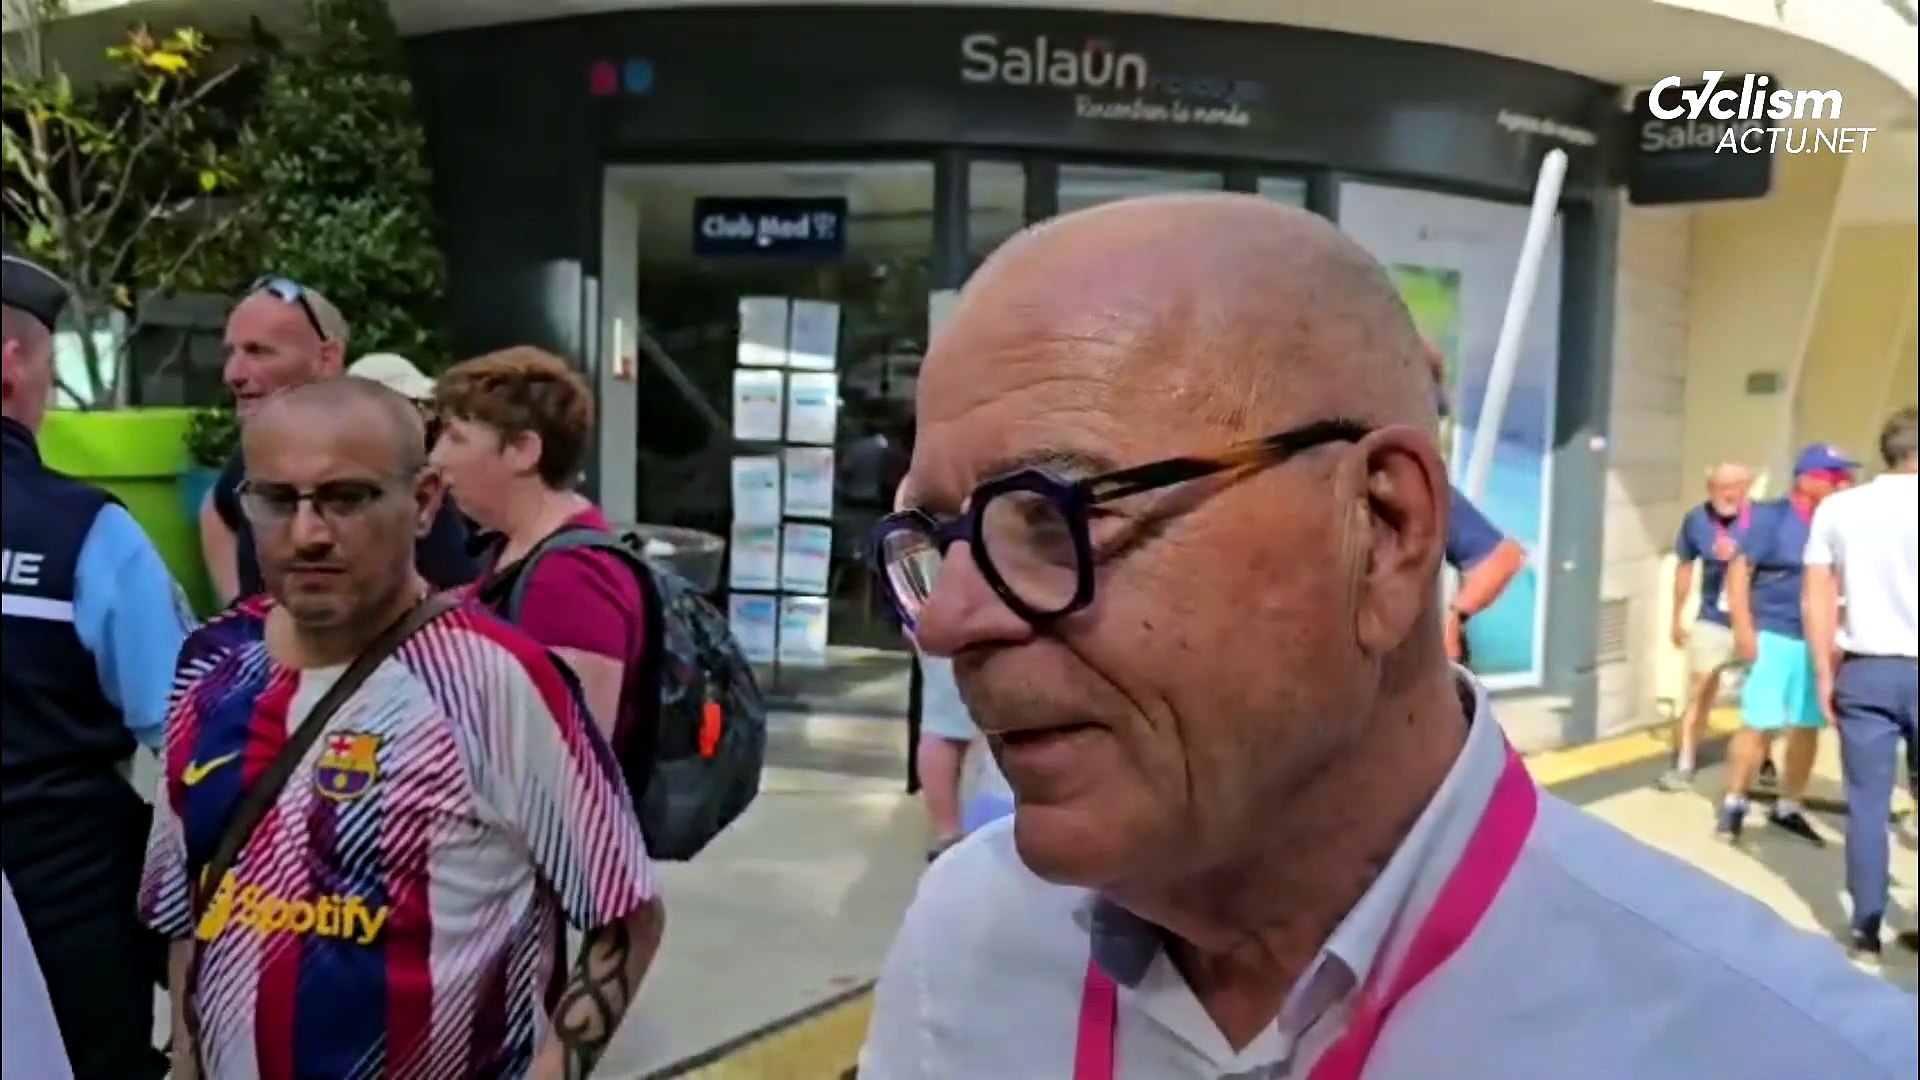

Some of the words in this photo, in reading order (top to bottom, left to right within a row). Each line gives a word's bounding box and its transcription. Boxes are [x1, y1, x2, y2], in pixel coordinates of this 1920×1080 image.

[701, 213, 755, 238] Club
[758, 213, 810, 239] Med
[236, 884, 390, 946] Spotify
